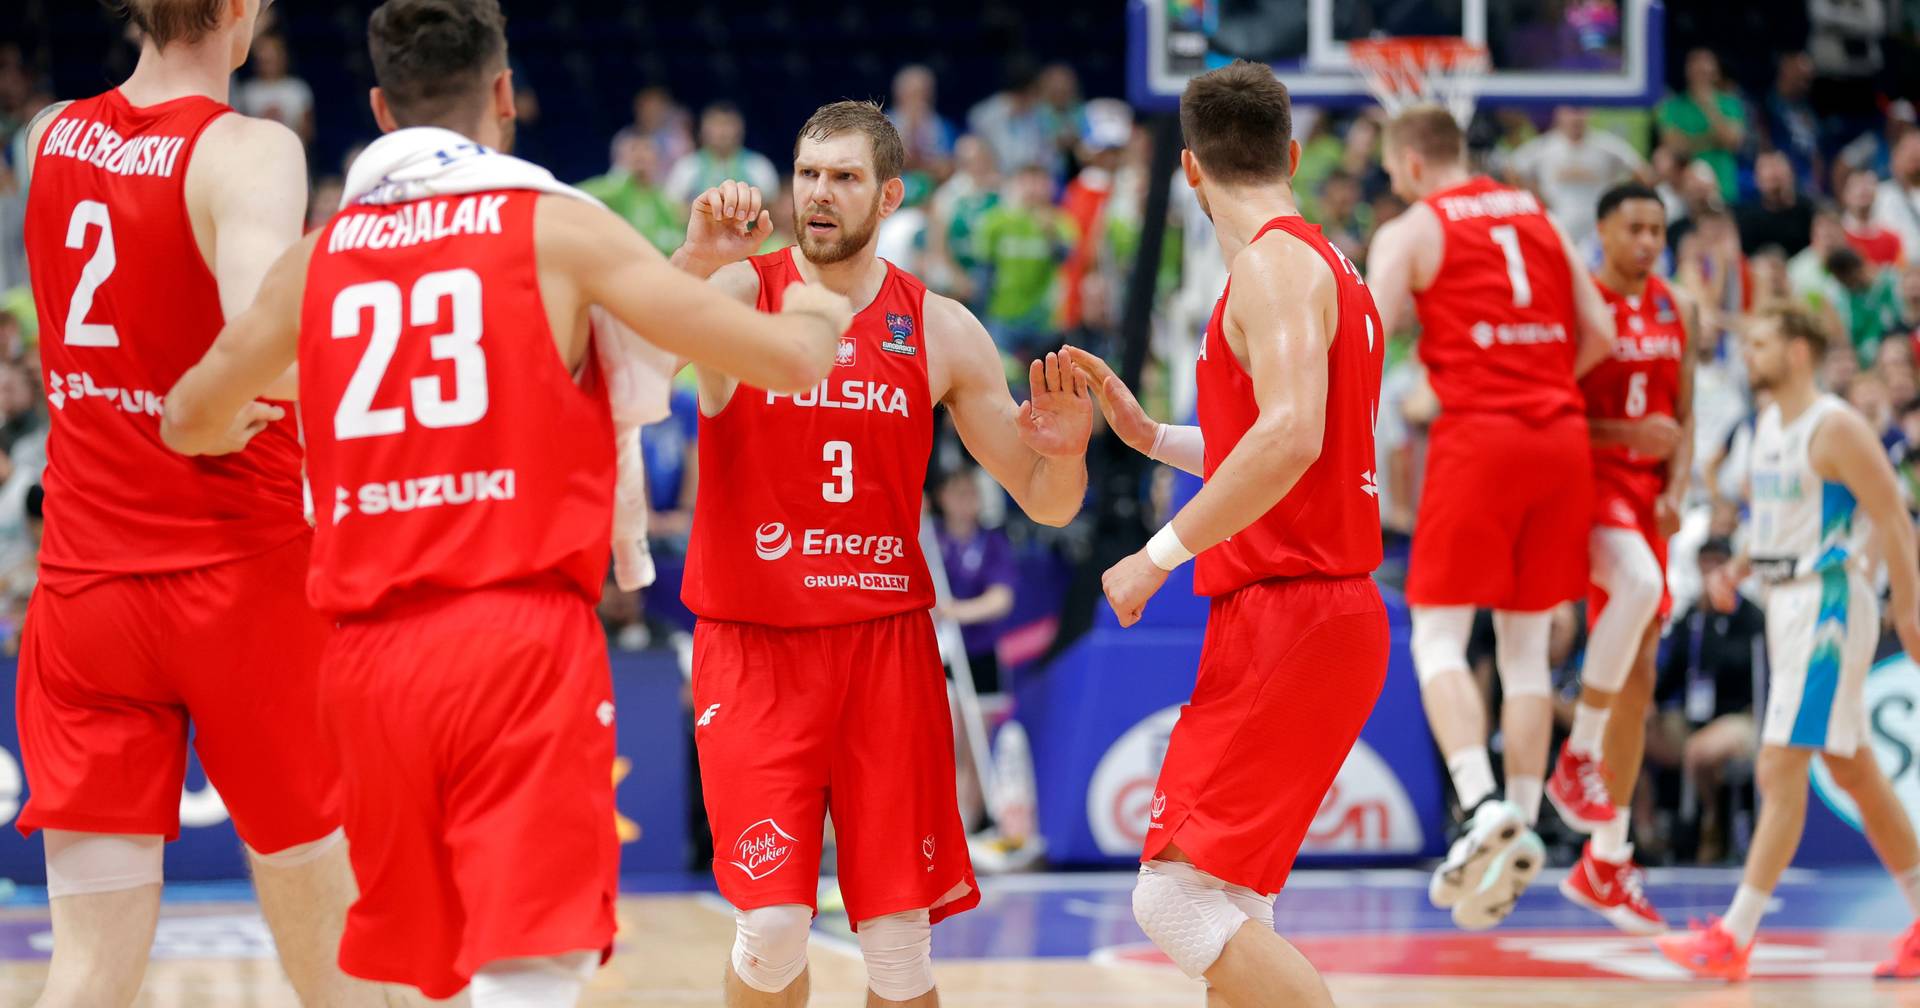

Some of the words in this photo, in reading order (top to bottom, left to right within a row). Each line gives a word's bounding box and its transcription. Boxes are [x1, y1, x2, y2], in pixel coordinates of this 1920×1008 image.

[328, 195, 508, 254] MICHALAK
[64, 199, 120, 347] 2
[1489, 224, 1533, 309] 1
[331, 267, 489, 441] 23
[357, 469, 516, 515] SUZUKI
[822, 440, 854, 503] 3
[802, 529, 905, 564] Energa
[804, 575, 859, 588] GRUPA
[862, 575, 907, 590] ORLEN
[739, 832, 776, 859] Polski
[749, 845, 789, 869] Cukier
